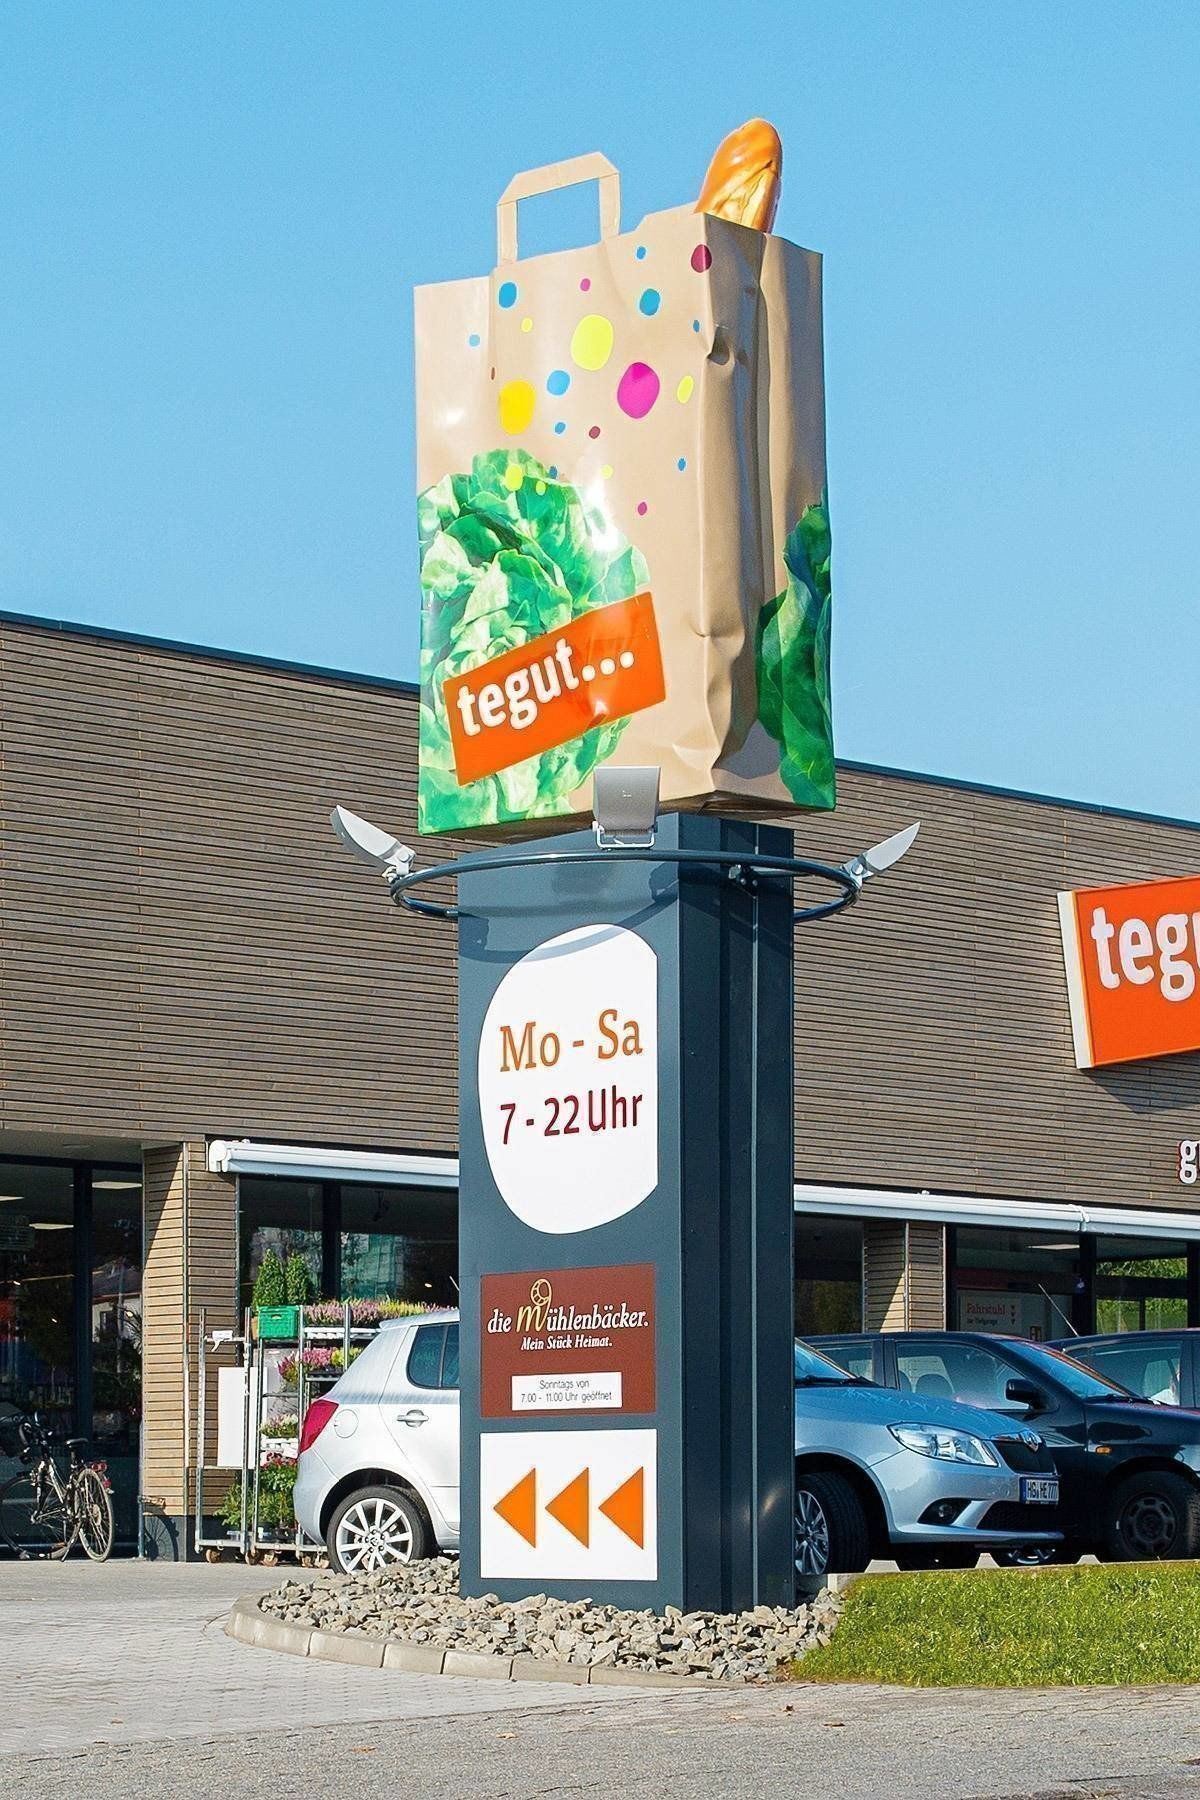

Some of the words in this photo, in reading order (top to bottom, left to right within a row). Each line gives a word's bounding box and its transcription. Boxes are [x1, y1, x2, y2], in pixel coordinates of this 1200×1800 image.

[500, 1021, 560, 1072] Mo
[598, 1009, 643, 1059] Sa
[500, 1103, 516, 1144] 7
[544, 1095, 579, 1136] 22
[588, 1085, 643, 1131] Uhr
[487, 1308, 512, 1333] die
[521, 1336, 544, 1350] Mein
[547, 1335, 572, 1349] Stück
[574, 1333, 613, 1347] Heimat.
[539, 1379, 574, 1391] Sonntags
[576, 1380, 590, 1388] von
[565, 1392, 578, 1401] Uhr
[581, 1391, 612, 1403] geöffnet
